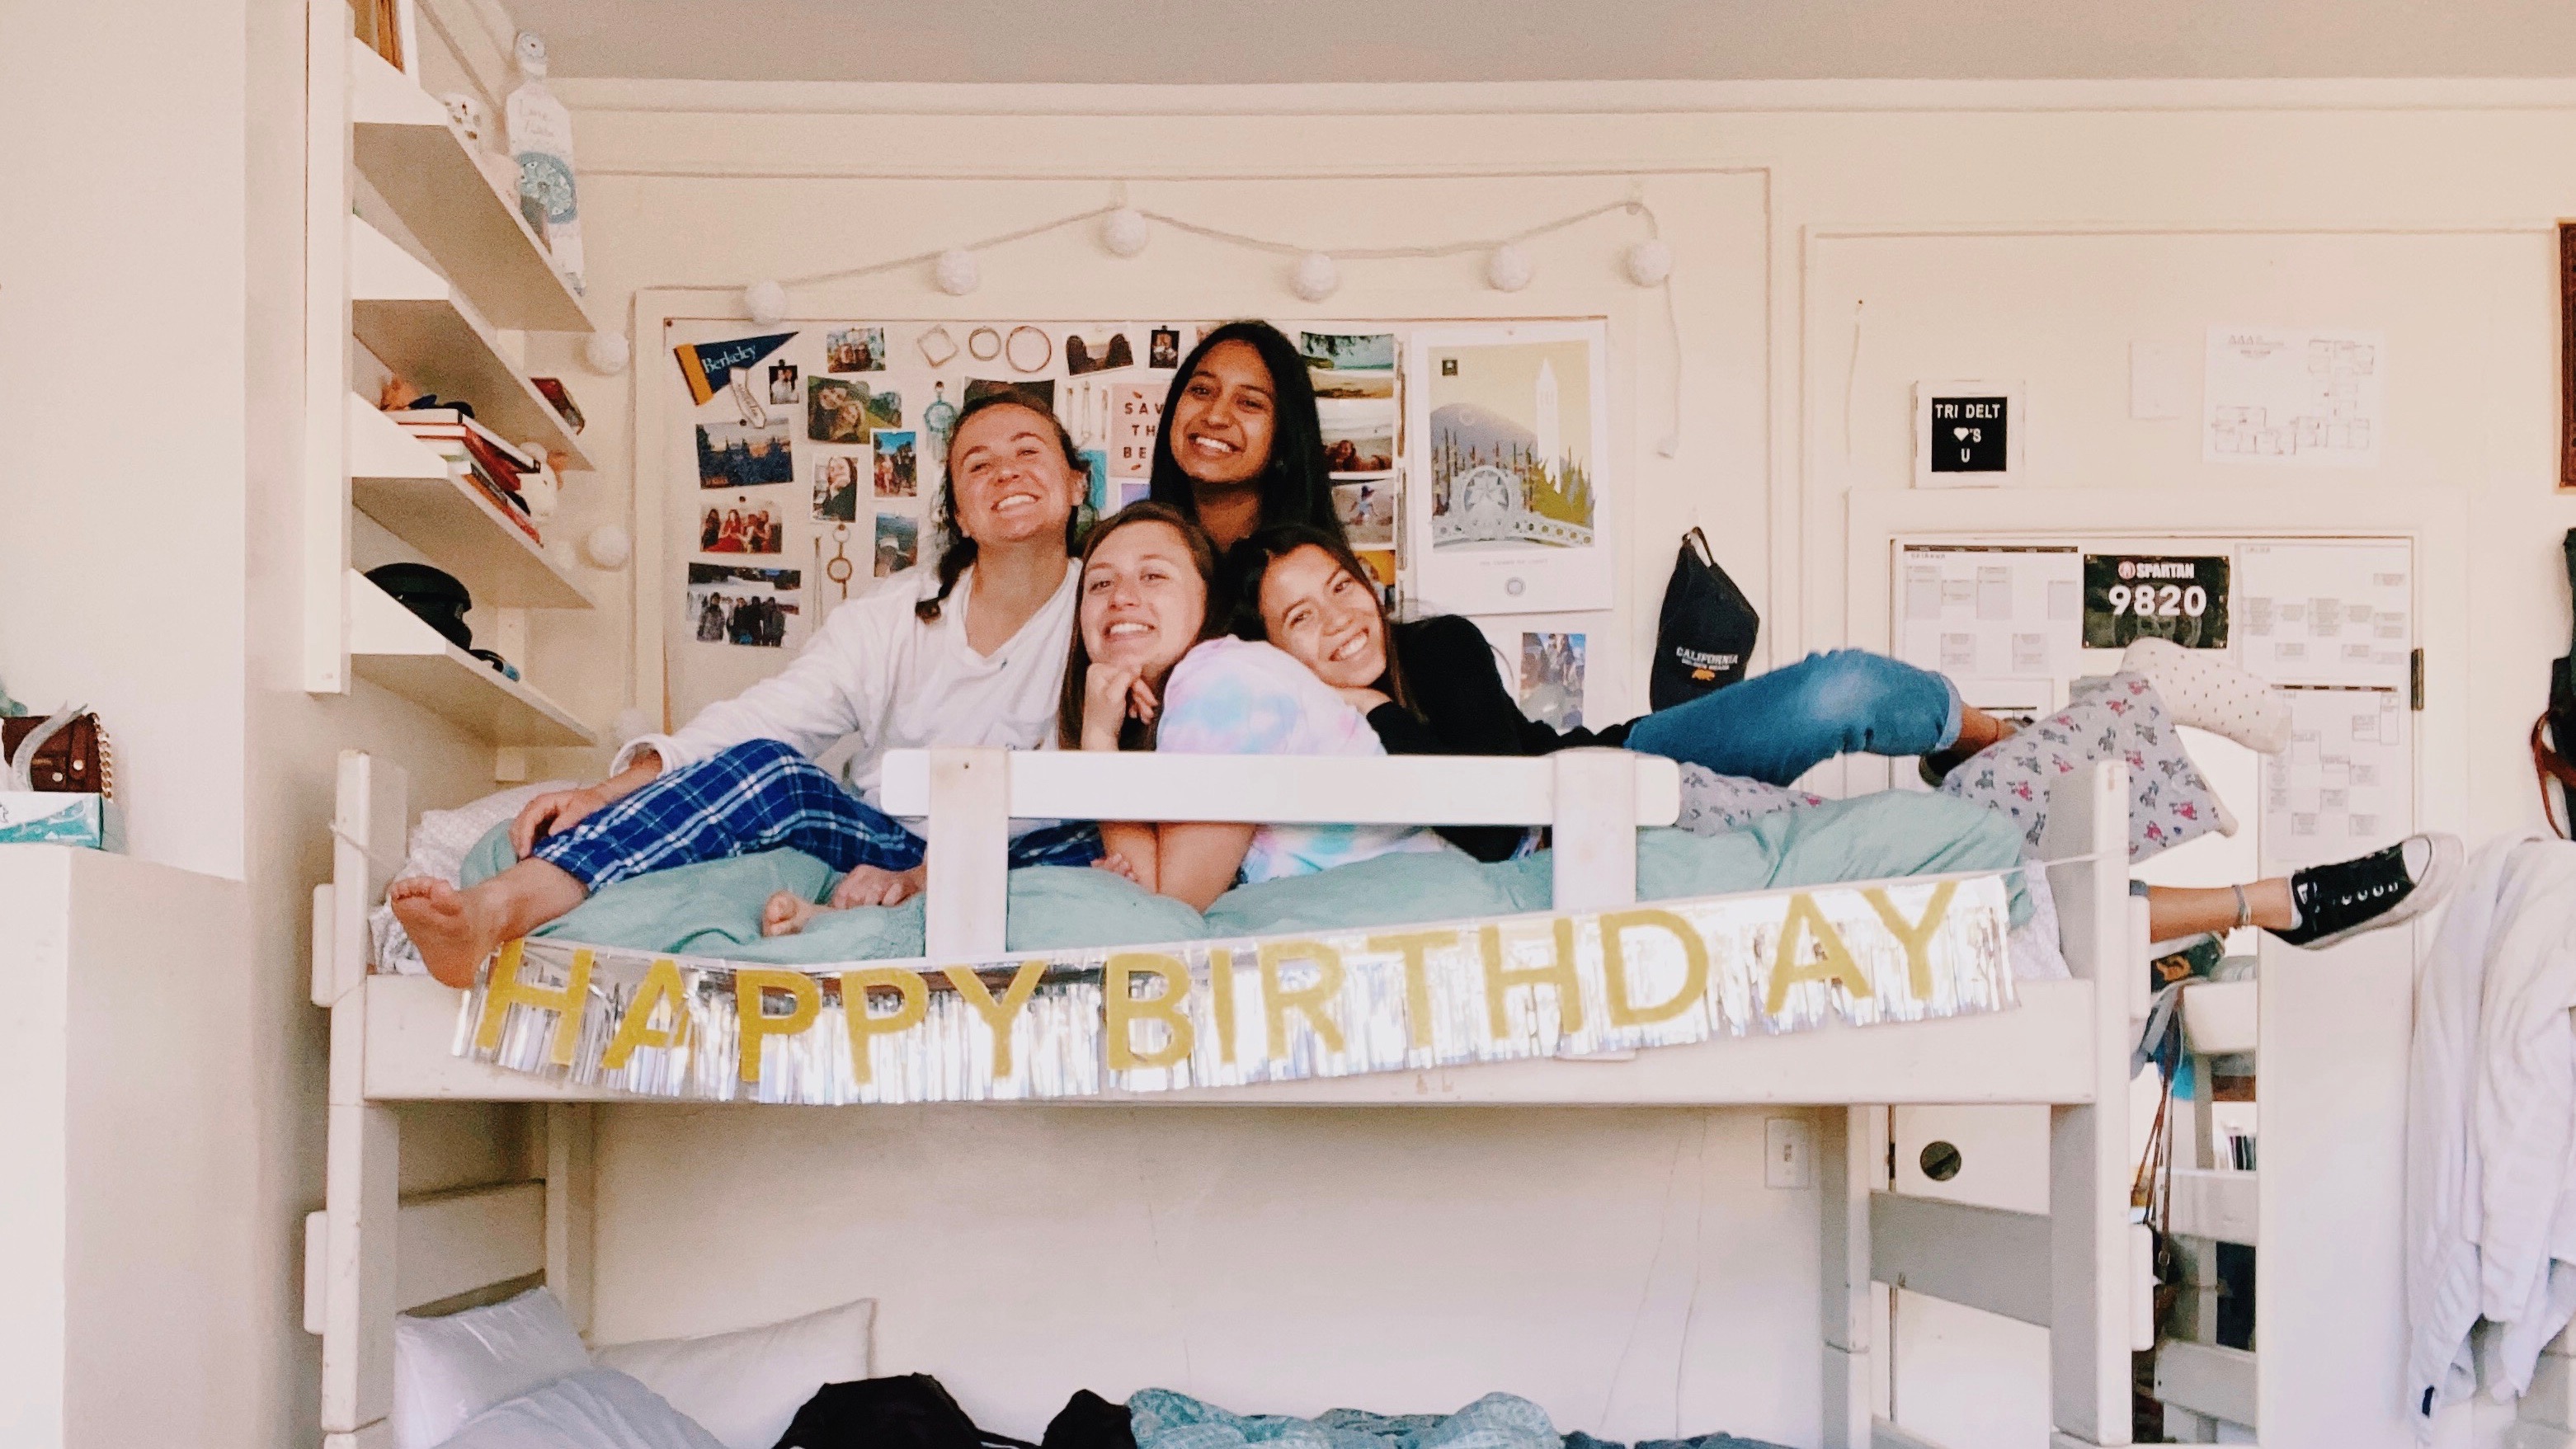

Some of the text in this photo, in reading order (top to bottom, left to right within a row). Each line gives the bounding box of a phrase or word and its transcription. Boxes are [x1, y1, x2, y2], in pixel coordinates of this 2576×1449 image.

[702, 346, 756, 374] Berkeley
[1124, 402, 1165, 414] SAV
[1935, 403, 2000, 418] TRI DELT
[1131, 424, 1156, 436] TH
[1123, 446, 1147, 459] BE
[1961, 448, 1971, 463] U
[2136, 562, 2195, 579] SPARTAN
[2108, 584, 2207, 617] 9820
[1676, 647, 1738, 664] CALIFORNIA
[475, 879, 1958, 1085] HAPPY BIRTHDAY
